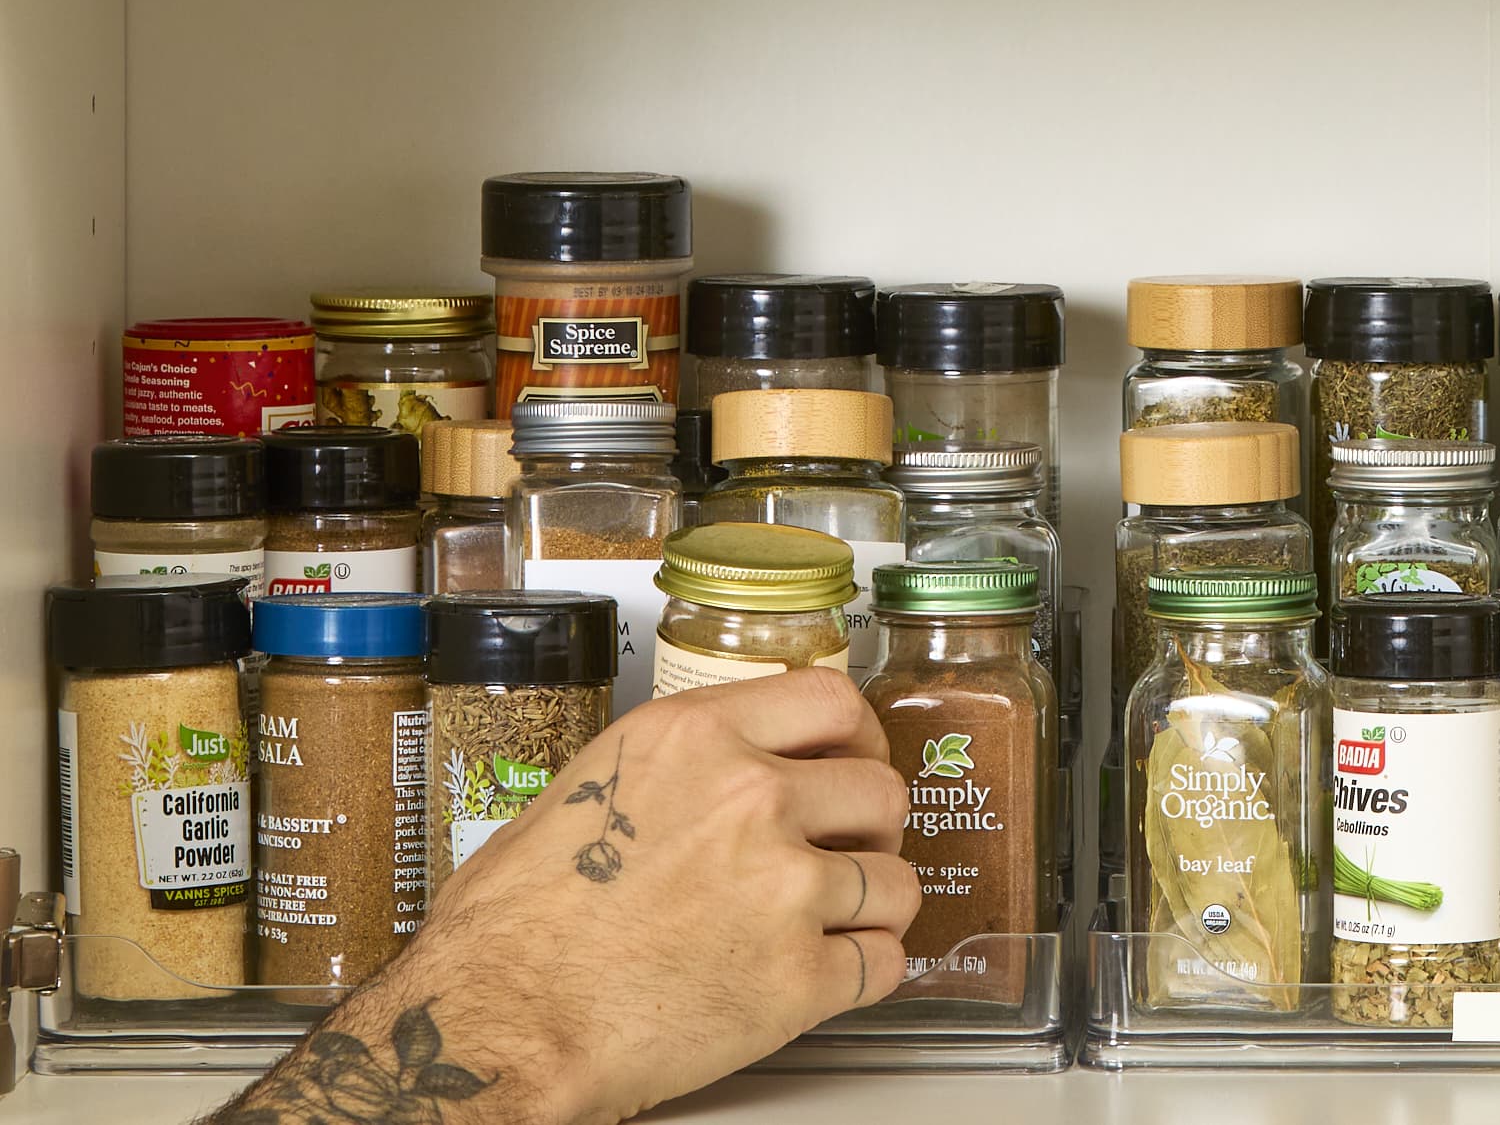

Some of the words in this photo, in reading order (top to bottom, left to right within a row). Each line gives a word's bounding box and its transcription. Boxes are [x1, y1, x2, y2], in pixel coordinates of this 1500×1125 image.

[565, 323, 615, 344] Spice
[549, 339, 632, 357] Supreme
[131, 362, 158, 372] Cajun's
[160, 364, 197, 373] Choice
[141, 375, 190, 388] Seasoning
[186, 733, 226, 756] Just
[1339, 744, 1380, 769] BADIA
[501, 766, 551, 789] Just
[1170, 764, 1266, 801] Simply
[162, 787, 239, 816] California
[182, 818, 229, 841] Garlic
[268, 816, 333, 833] BASSETT
[1337, 818, 1389, 836] Cebollinos
[175, 843, 235, 869] Powder
[1179, 854, 1212, 875] bay
[1218, 855, 1255, 874] leaf
[271, 873, 294, 885] SALT
[296, 876, 327, 887] FREE
[164, 887, 211, 901] VANNS
[214, 885, 244, 897] SPICES
[271, 886, 327, 899] NON-GMO
